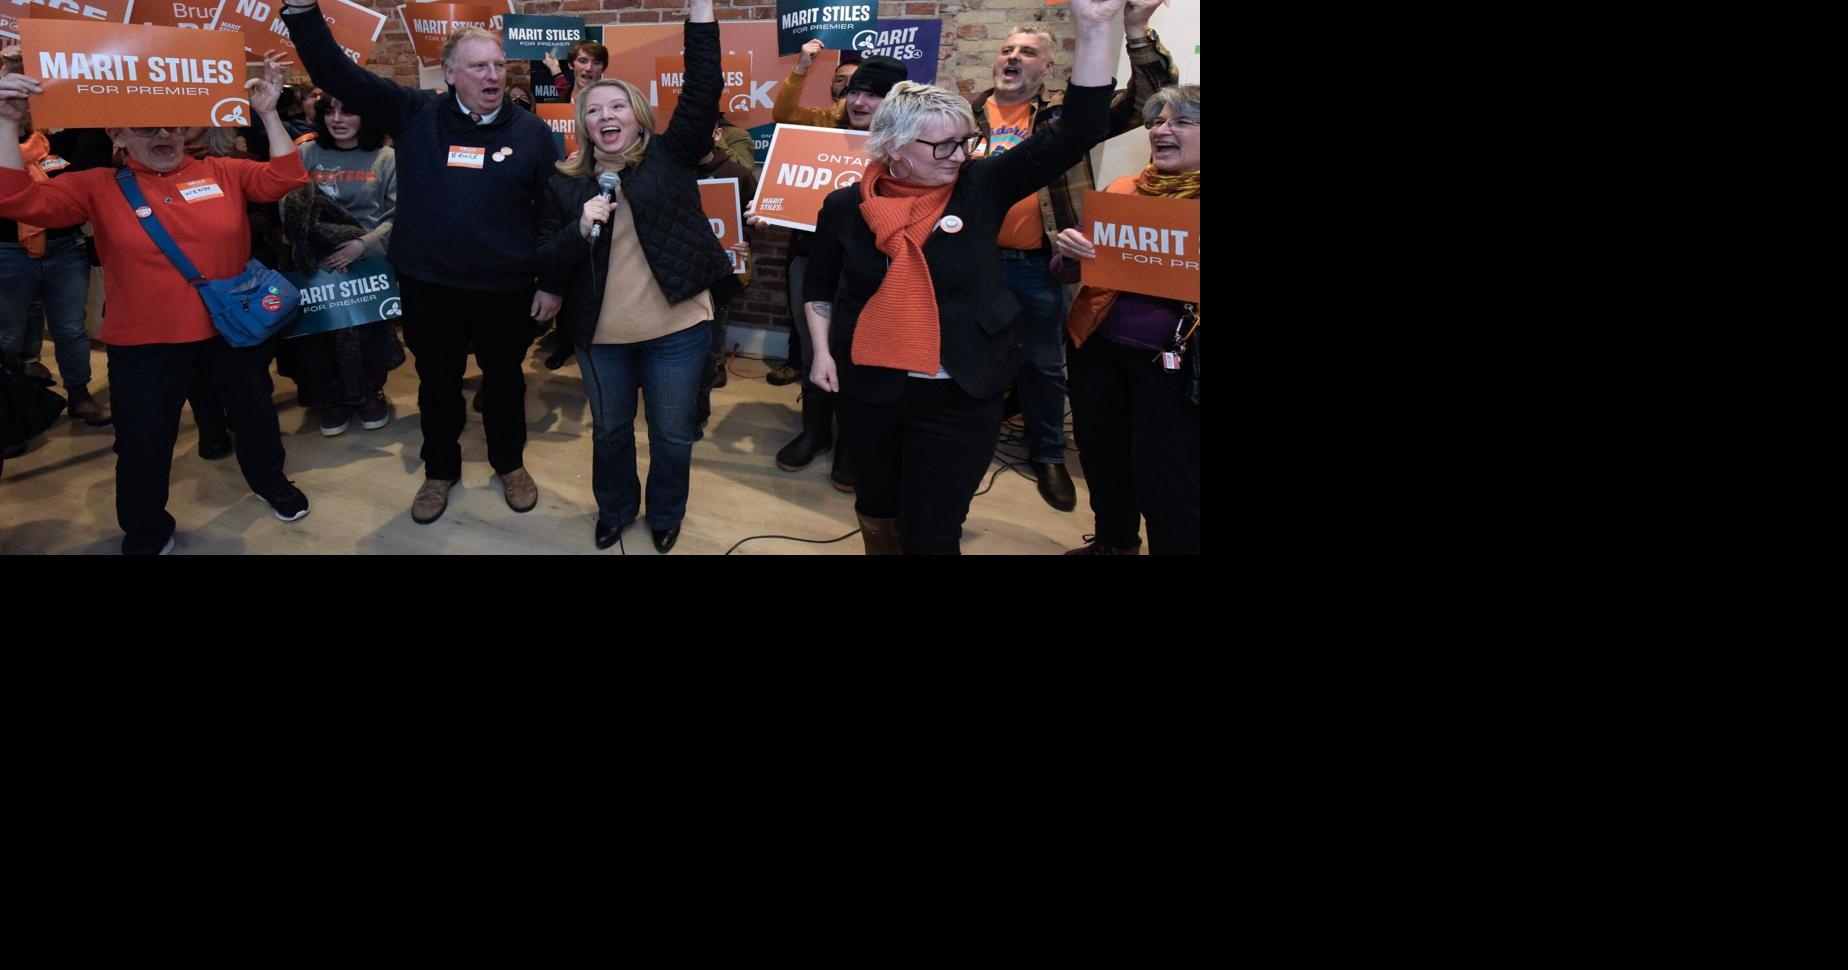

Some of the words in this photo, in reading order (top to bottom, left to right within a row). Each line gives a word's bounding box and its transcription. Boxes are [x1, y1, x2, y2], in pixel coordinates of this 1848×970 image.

[173, 2, 217, 18] Bruc
[782, 8, 819, 30] MARIT
[822, 5, 870, 22] STILES
[414, 18, 447, 34] MARIT
[508, 27, 543, 40] MARIT
[545, 29, 580, 41] STILES
[793, 26, 808, 35] FOR
[876, 27, 918, 46] ARIT
[39, 52, 139, 81] MARIT
[147, 56, 234, 84] STILES
[77, 84, 119, 94] FOR
[126, 86, 210, 96] PREMIER
[753, 140, 769, 150] DP
[776, 163, 833, 190] NDP
[1093, 221, 1189, 256] MARIT
[1122, 253, 1163, 266] FOR
[299, 283, 336, 306] ARIT
[339, 273, 390, 298] STILES
[303, 304, 327, 314] FOR
[329, 294, 377, 309] PREMIER
